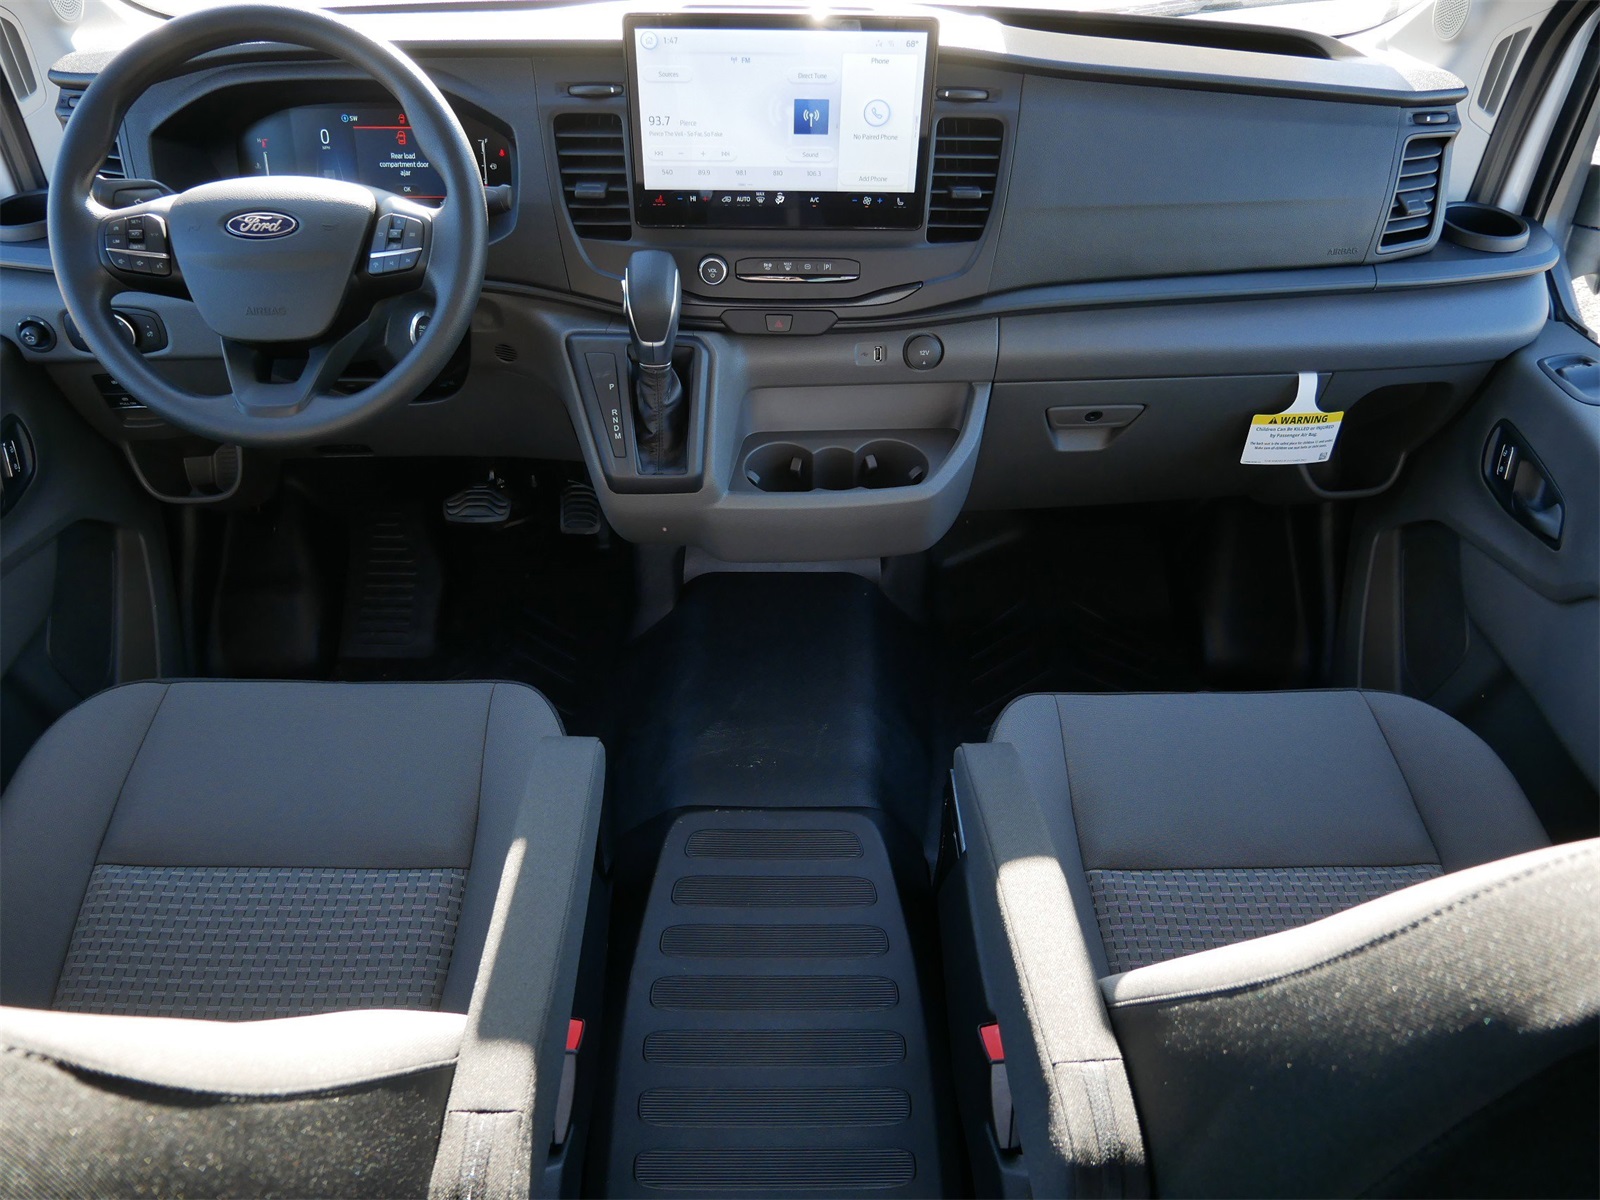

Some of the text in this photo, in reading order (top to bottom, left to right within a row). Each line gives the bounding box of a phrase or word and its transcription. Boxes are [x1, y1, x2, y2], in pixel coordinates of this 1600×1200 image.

[648, 116, 670, 126] 93.7
[320, 129, 329, 144] 0
[240, 216, 282, 231] Ford
[246, 306, 287, 316] AIRBAG
[1280, 415, 1328, 424] WARNING
